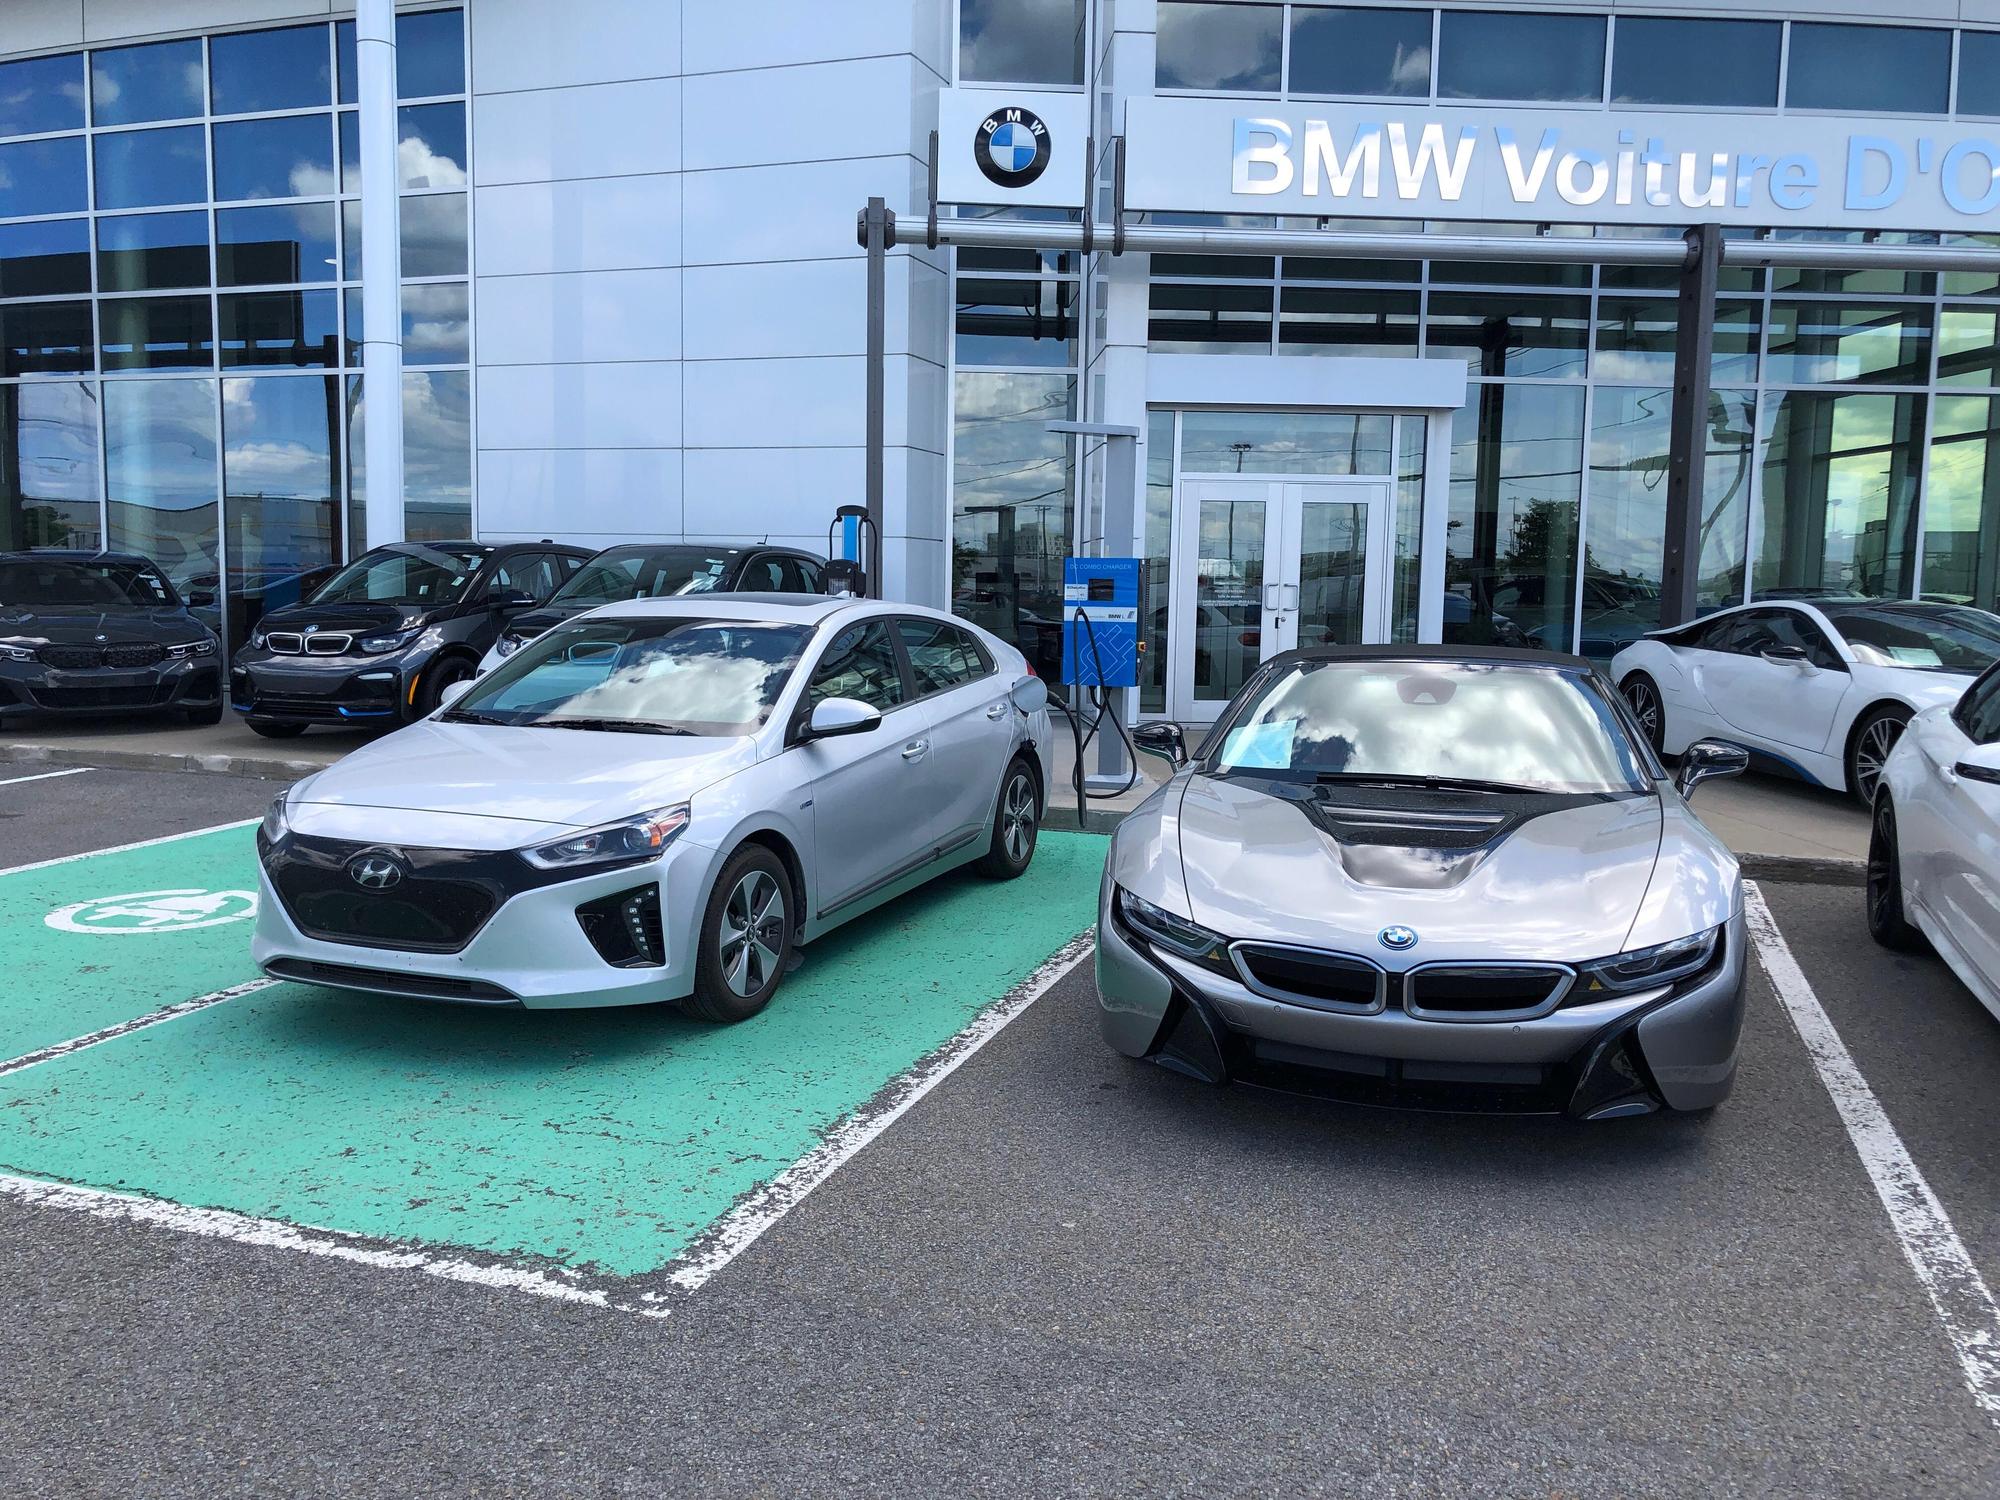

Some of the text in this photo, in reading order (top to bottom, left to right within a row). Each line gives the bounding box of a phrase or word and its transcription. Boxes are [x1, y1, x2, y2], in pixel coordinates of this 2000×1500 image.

[982, 109, 1046, 137] BMW
[1230, 117, 1479, 202] BMW
[1494, 126, 1821, 212] Voiture
